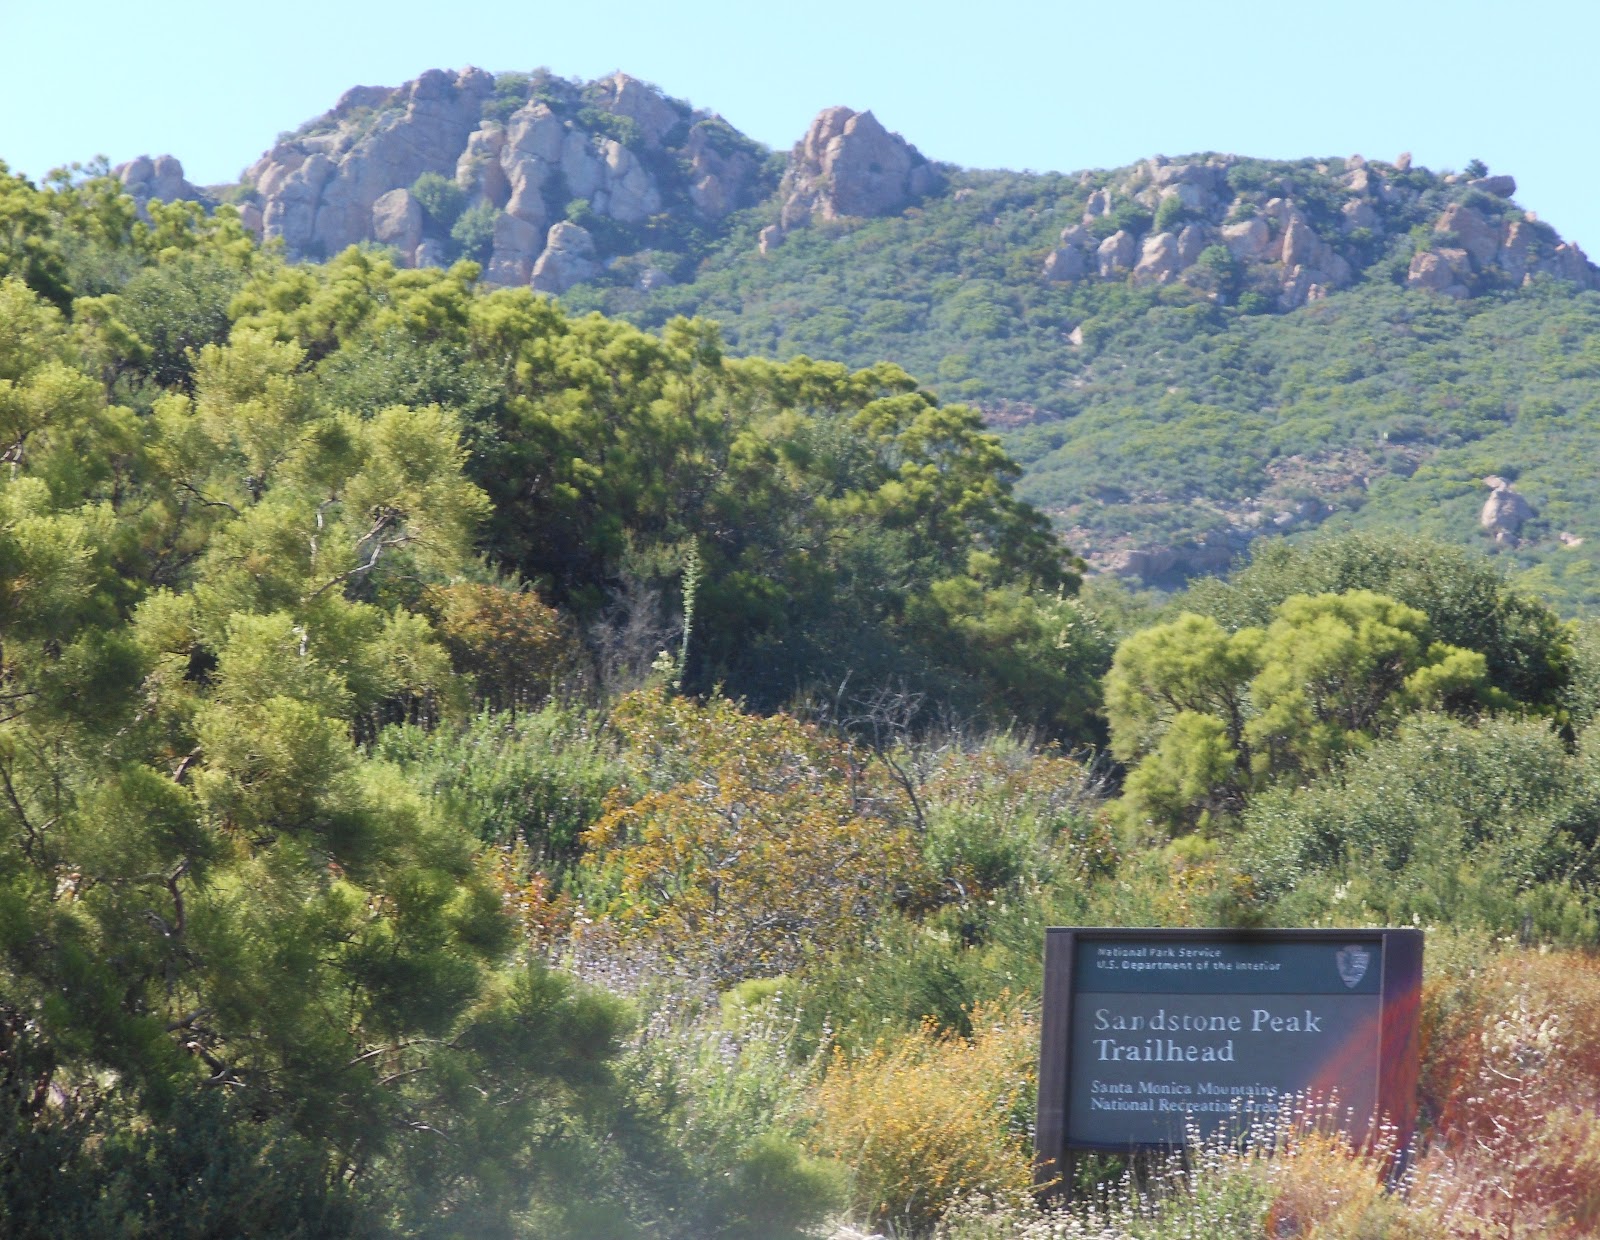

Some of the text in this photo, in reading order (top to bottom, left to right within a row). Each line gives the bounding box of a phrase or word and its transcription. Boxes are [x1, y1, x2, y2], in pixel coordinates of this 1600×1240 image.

[1097, 947, 1222, 957] National Park Service
[1096, 960, 1281, 972] U.S. Department of the Interior
[1094, 1008, 1322, 1033] Sandstone Peak
[1093, 1039, 1235, 1062] Trailhead
[1090, 1080, 1278, 1096] Santa Monica Mountains
[1090, 1097, 1154, 1111] National
